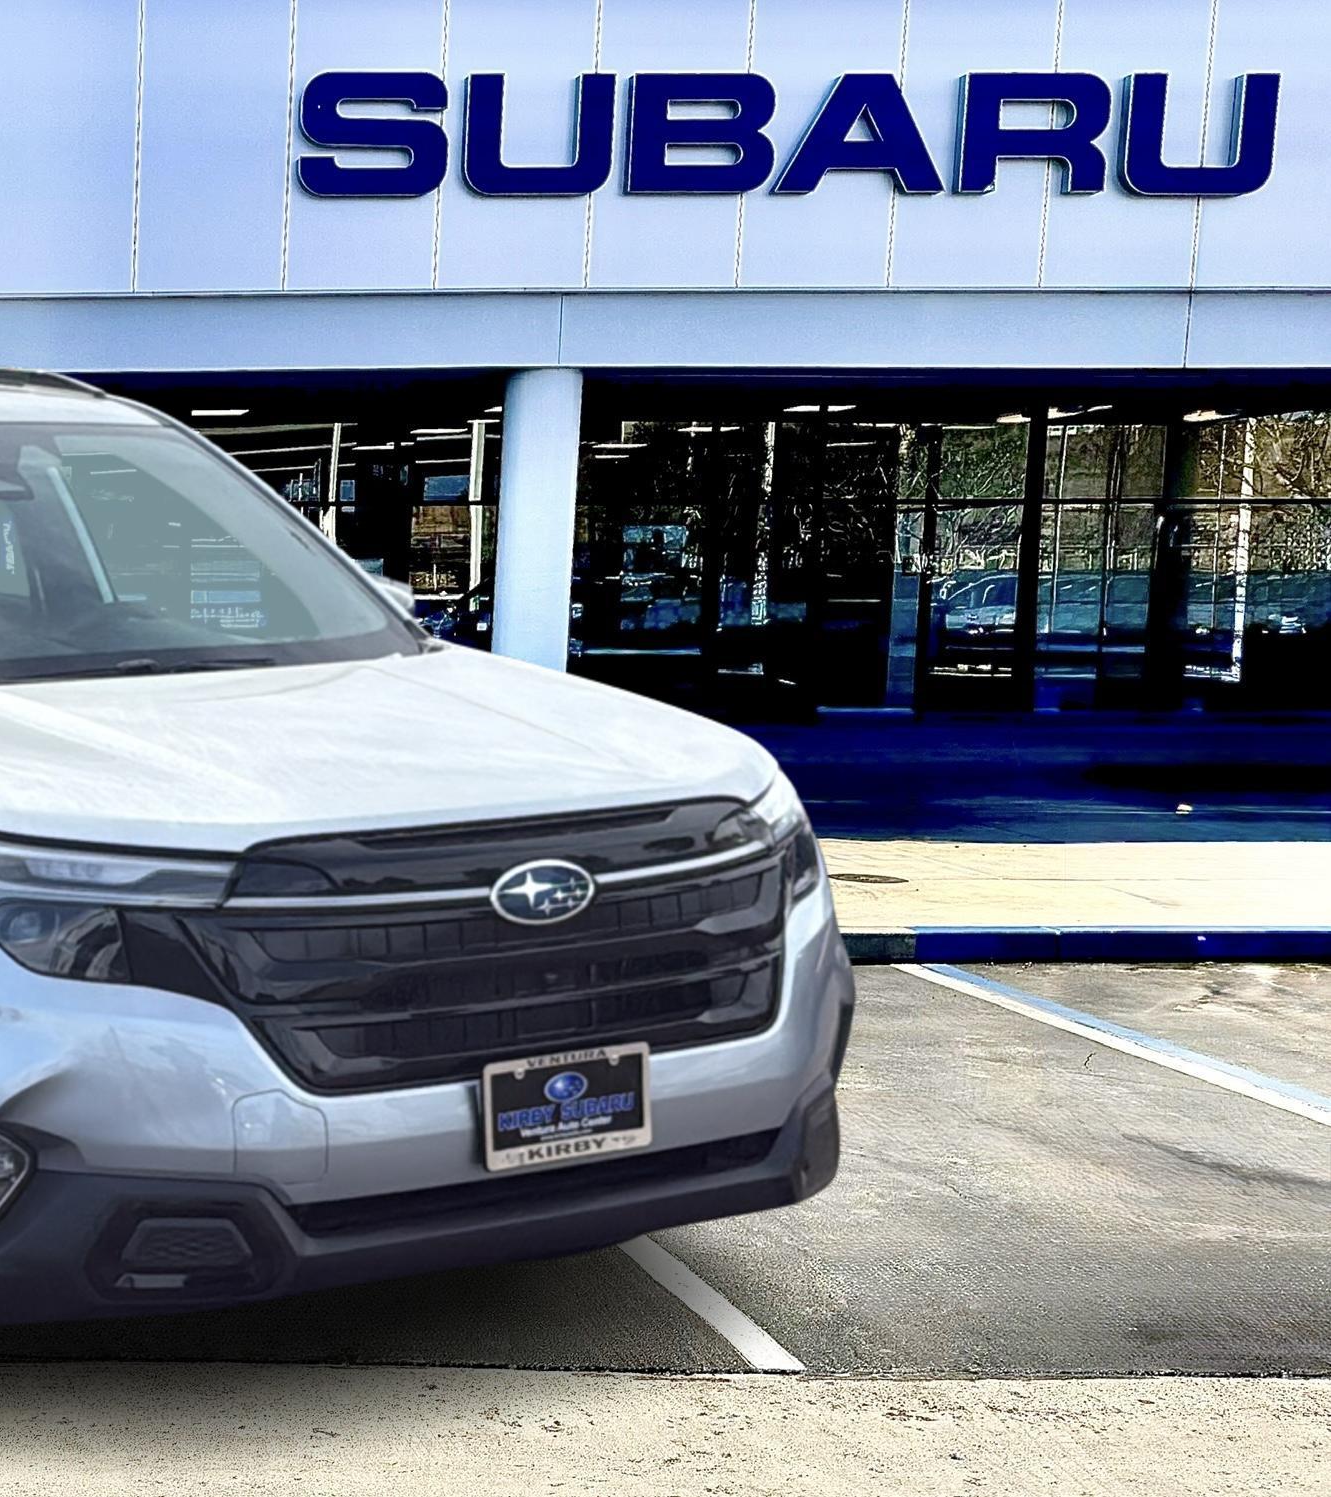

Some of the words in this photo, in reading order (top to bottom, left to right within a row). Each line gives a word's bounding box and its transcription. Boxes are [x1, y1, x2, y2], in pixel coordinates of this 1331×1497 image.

[298, 71, 1280, 198] SUBARU
[527, 1049, 606, 1068] VENTURA
[498, 1105, 556, 1131] KIRBY
[561, 1092, 635, 1120] SUBARU
[520, 1125, 555, 1138] Ventura
[558, 1120, 579, 1130] Auto
[581, 1116, 612, 1127] Center
[528, 1137, 606, 1160] KIRBY
